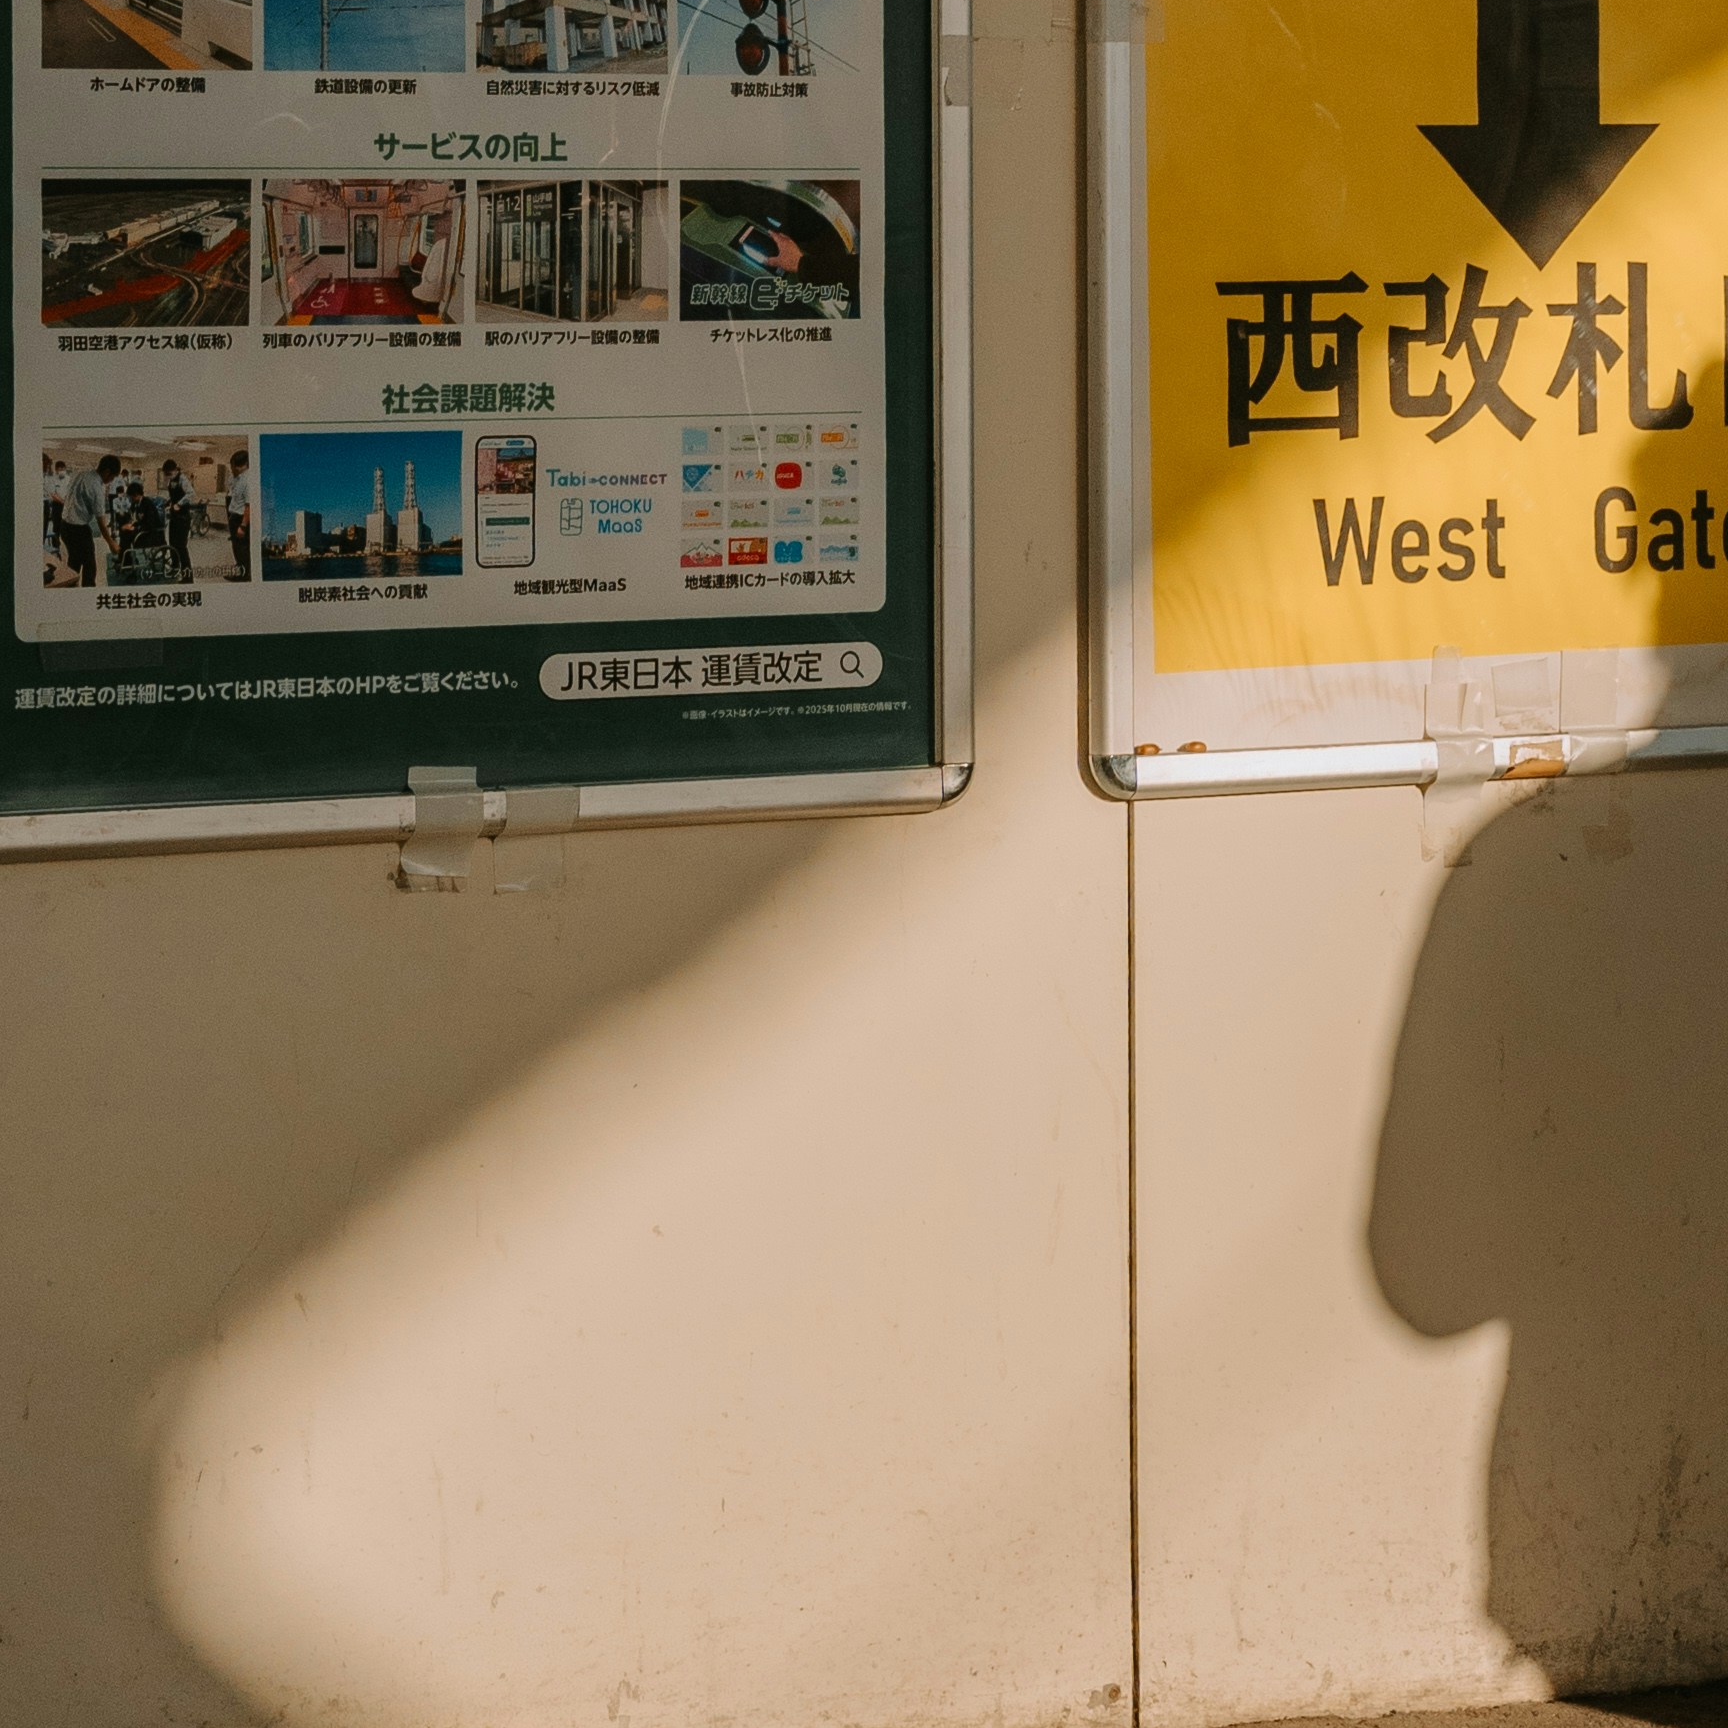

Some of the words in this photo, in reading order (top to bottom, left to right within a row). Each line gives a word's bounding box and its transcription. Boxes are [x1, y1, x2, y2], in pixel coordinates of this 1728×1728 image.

[90, 77, 206, 93] ホームドアの整備
[314, 78, 417, 95] 鉄道設備の更新
[486, 80, 660, 97] 自然災害に対するリスク低減
[730, 82, 809, 98] 事故防止対策
[374, 132, 568, 162] サービスの向上
[58, 332, 233, 352] 羽田空港アクセス線(仮称)
[262, 331, 462, 348] 列車のバリアフリー設備の整備
[485, 329, 660, 346] 駅のバリアフリー設備の整備
[710, 327, 832, 343] チケットレス化の推進
[382, 382, 555, 414] 社会課題解決
[546, 469, 586, 487] Tabi
[599, 474, 667, 486] CONNECT
[590, 498, 652, 514] TOHOKU
[598, 518, 643, 534] MaaS
[1313, 496, 1506, 586] West
[514, 577, 627, 596] 地域観光型MaaS
[685, 570, 856, 590] 地域連携ICカードの導入拡大
[96, 590, 202, 610] 共生社会の実現
[299, 583, 428, 603] 脱炭素社会への貢献
[560, 656, 693, 692] JR東日本
[701, 651, 822, 688] 運賃改定
[15, 671, 519, 710] 運賃改定の詳細についてはJR東日本のHPをご覧ください。
